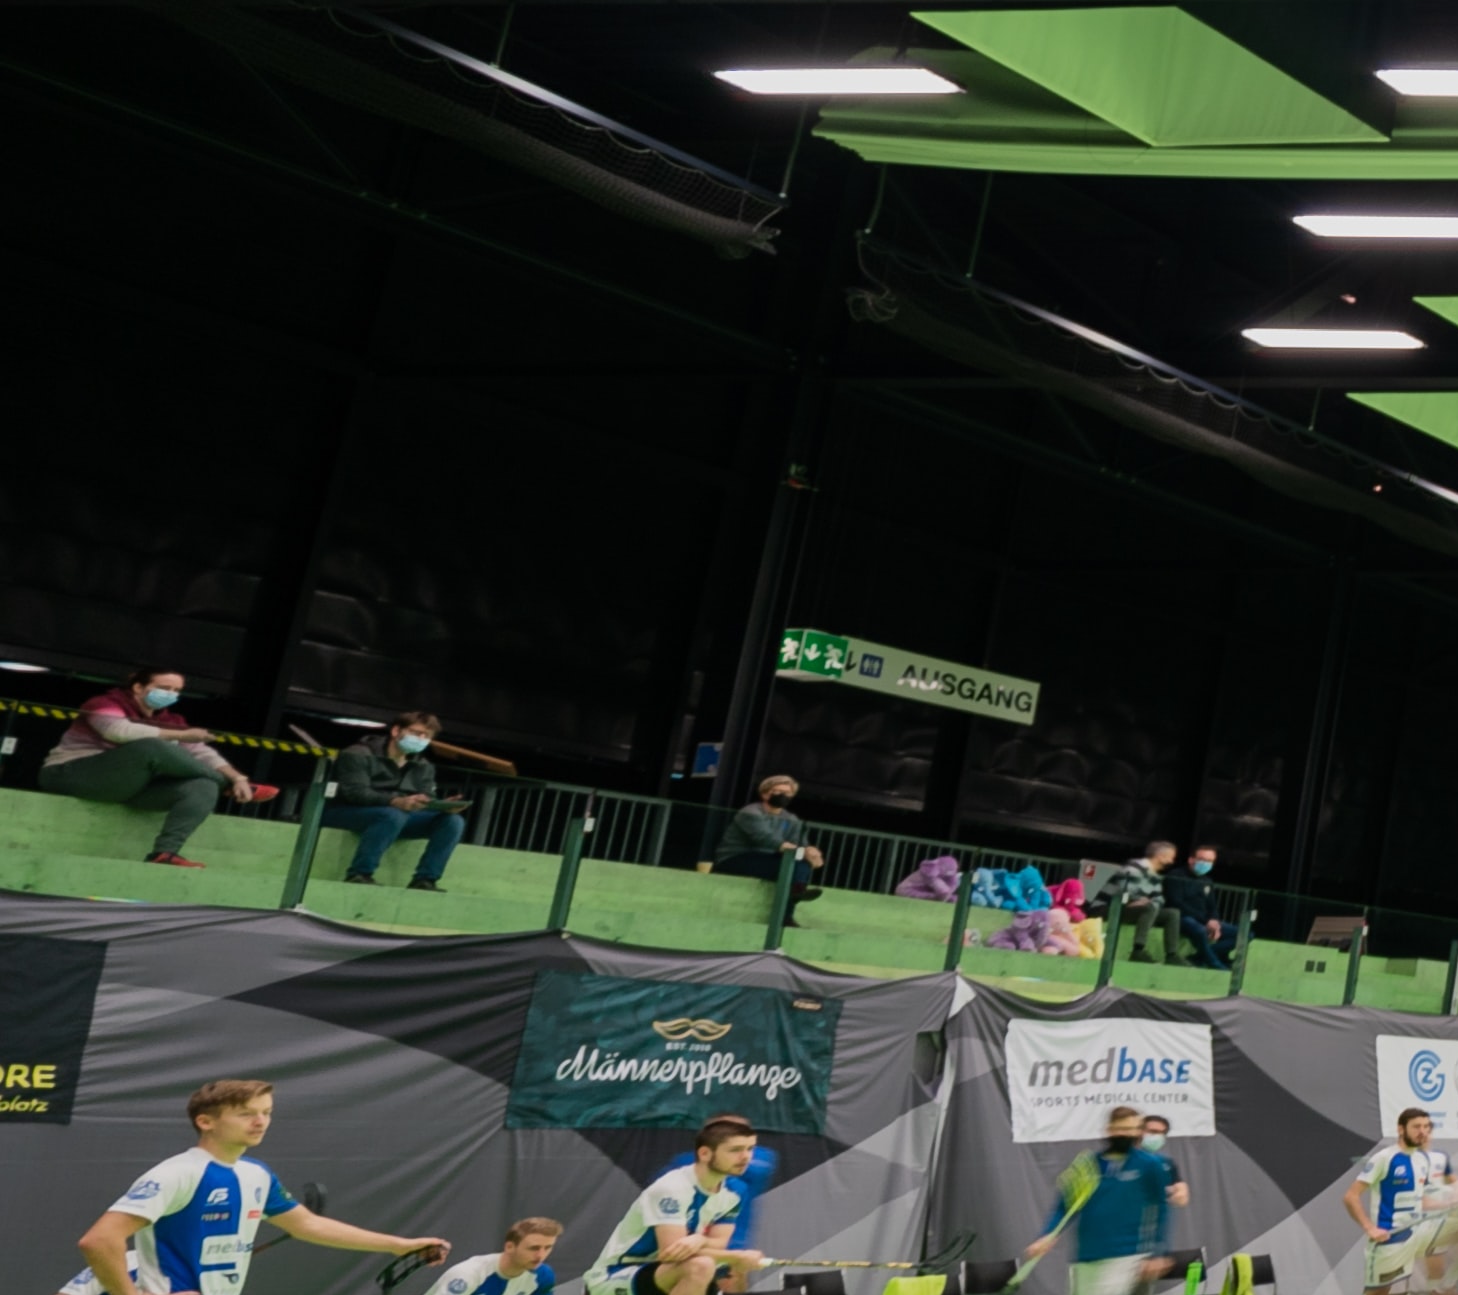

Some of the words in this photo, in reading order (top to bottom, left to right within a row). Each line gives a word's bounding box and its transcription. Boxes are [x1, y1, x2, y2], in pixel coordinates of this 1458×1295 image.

[901, 664, 1033, 713] AUSGANG
[0, 1064, 56, 1088] RE
[556, 1045, 801, 1100] Männerpflanze
[1031, 1095, 1080, 1108] SPORTS
[1084, 1093, 1138, 1105] MEDICAL
[1143, 1093, 1189, 1104] CENTER
